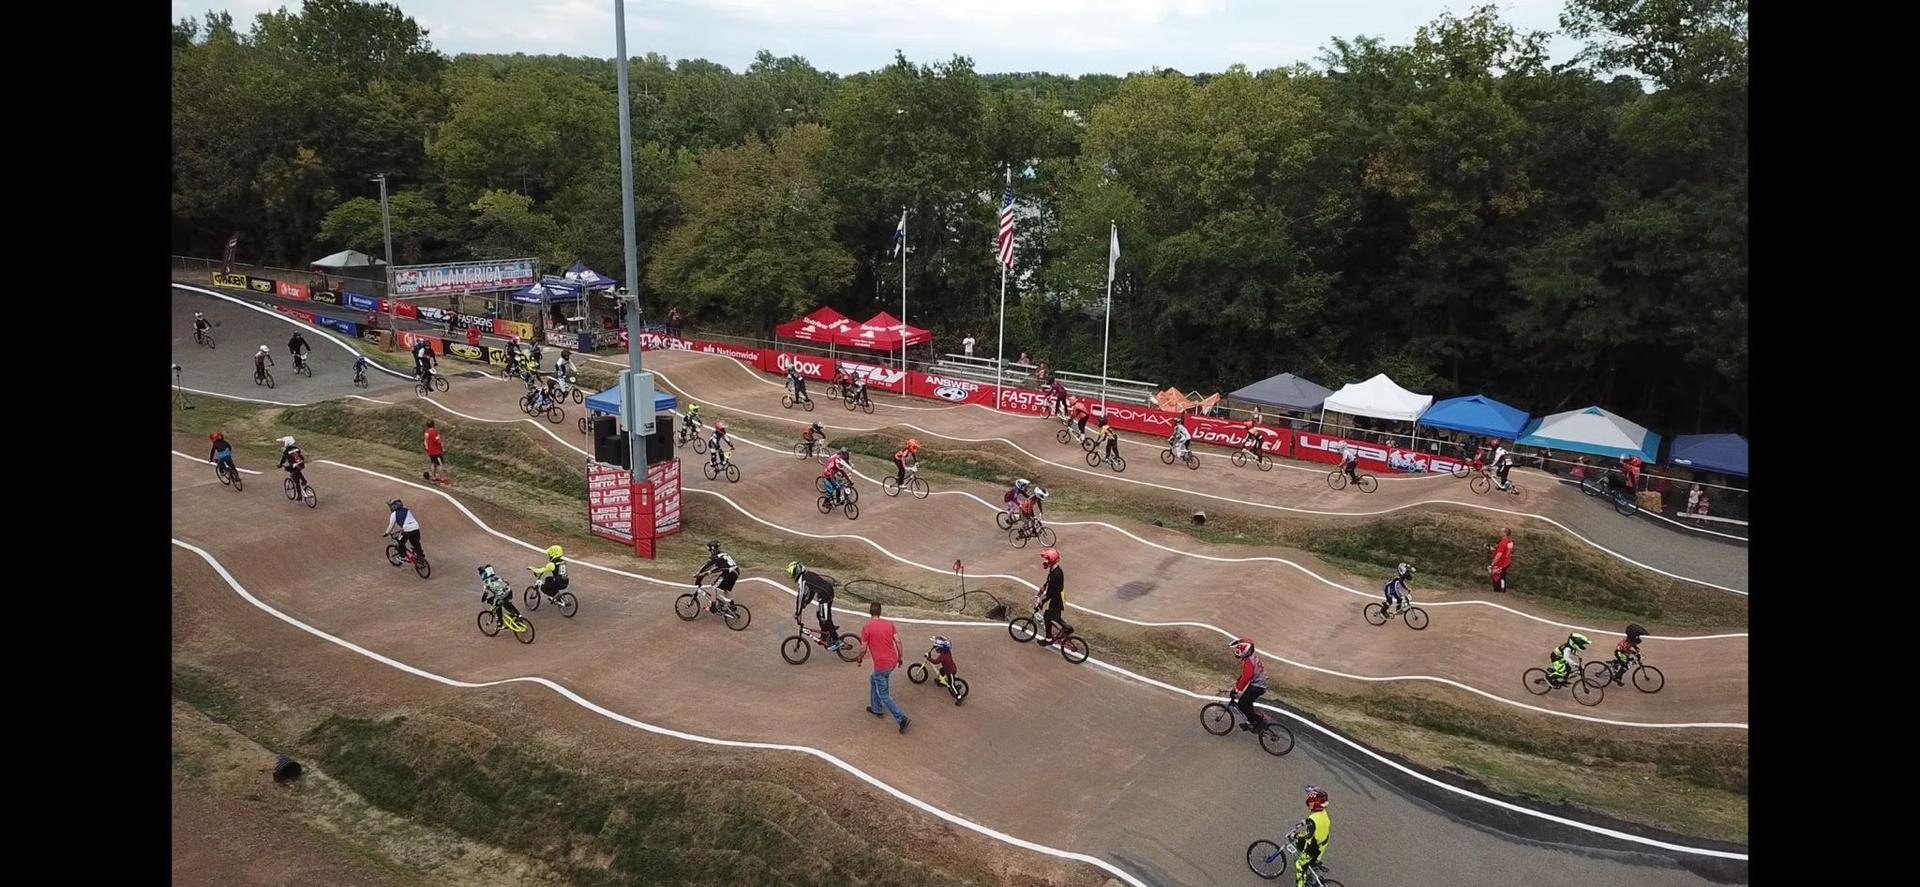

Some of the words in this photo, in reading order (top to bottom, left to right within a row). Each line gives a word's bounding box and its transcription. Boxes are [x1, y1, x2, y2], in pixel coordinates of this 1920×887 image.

[457, 313, 493, 328] FASTSIGNS
[716, 347, 758, 361] Nationwide
[793, 355, 822, 376] box
[925, 375, 979, 392] ANSWER
[1001, 390, 1074, 411] FASTSIGS
[1191, 427, 1282, 451] bombell
